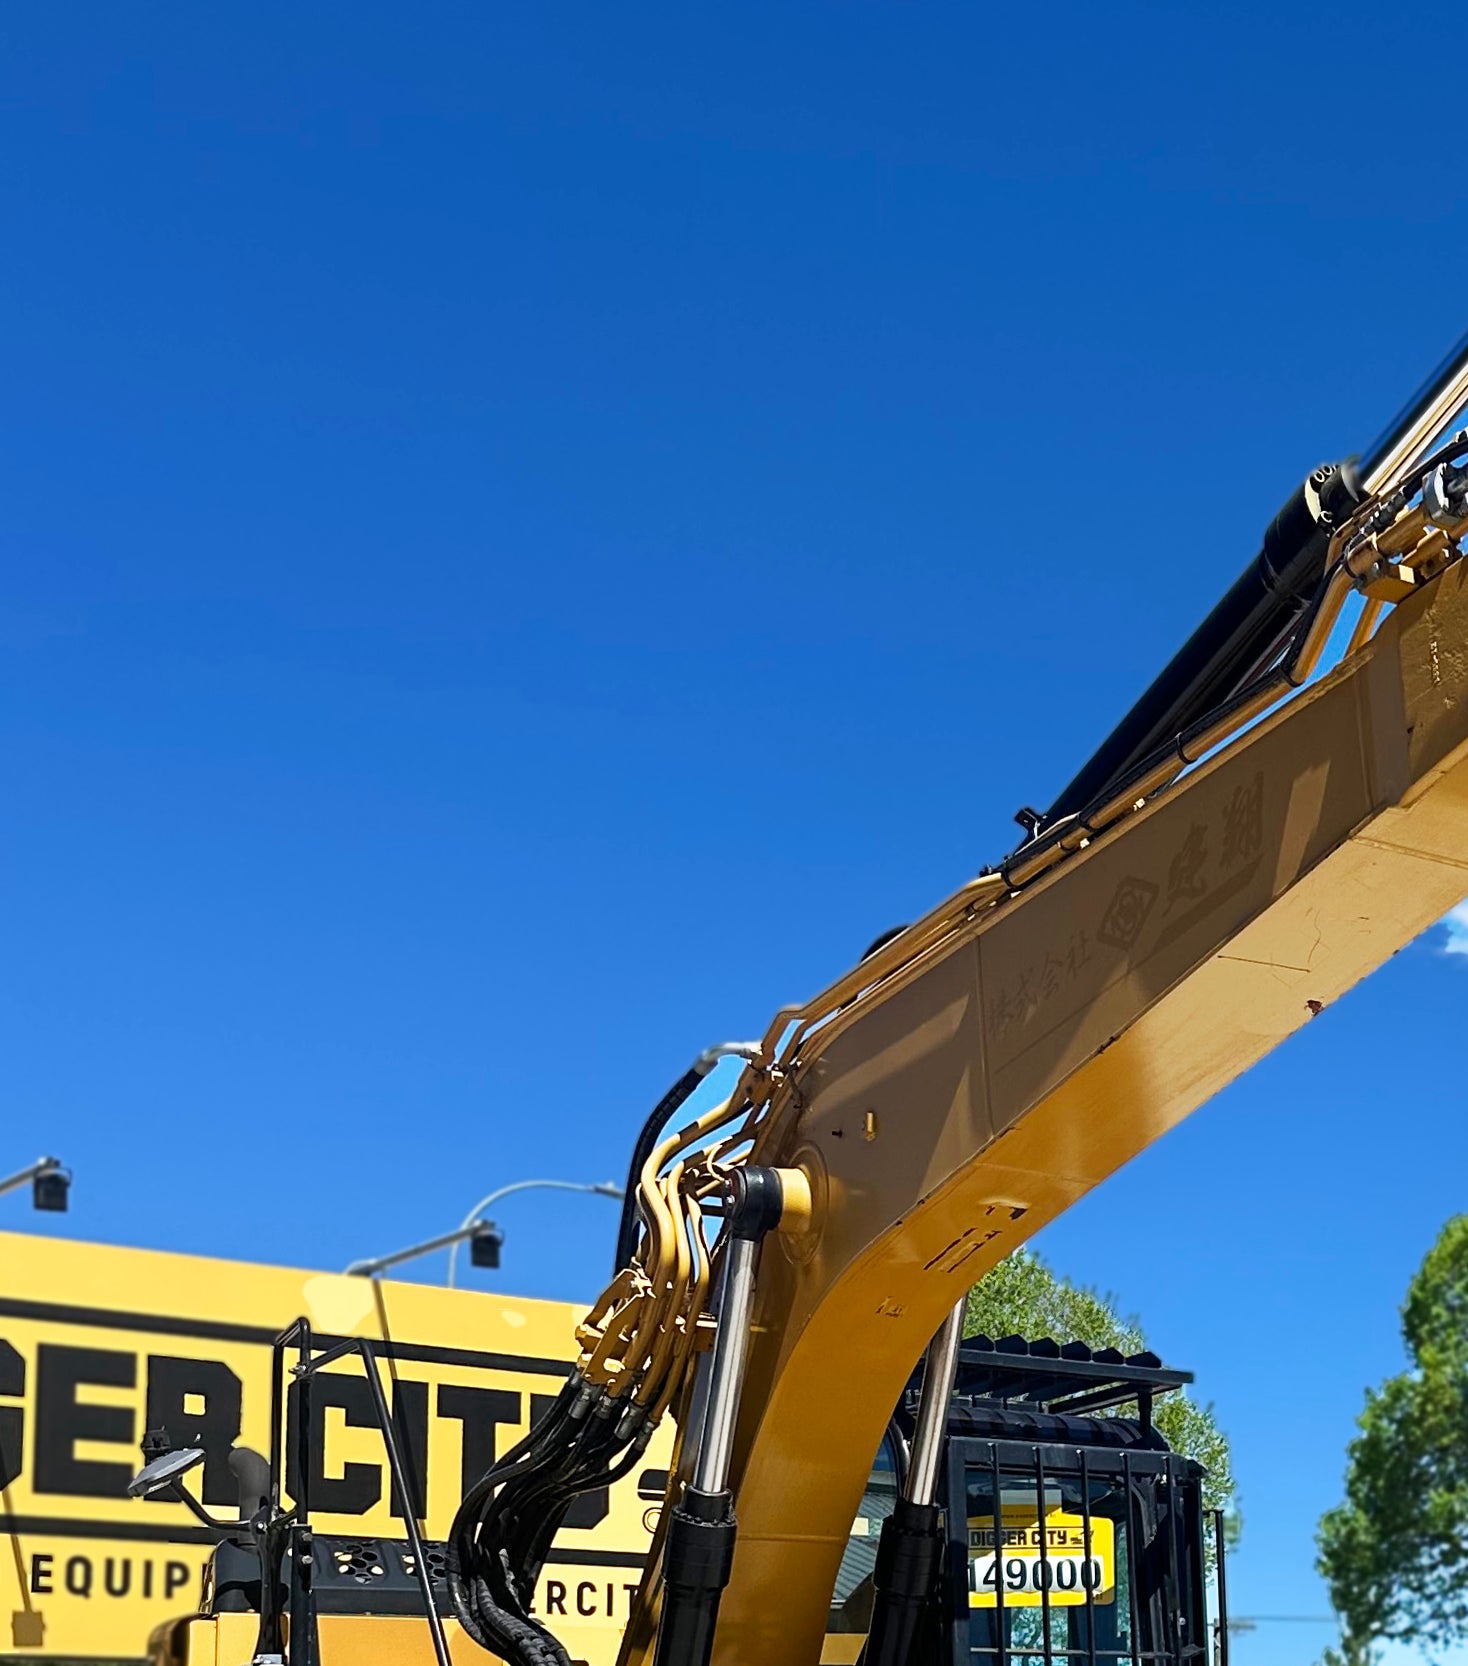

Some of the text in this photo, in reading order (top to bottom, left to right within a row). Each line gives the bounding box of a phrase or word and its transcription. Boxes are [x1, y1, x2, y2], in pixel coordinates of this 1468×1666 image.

[0, 1338, 243, 1508] ER
[1031, 1530, 1067, 1545] CTY
[31, 1554, 208, 1600] EQUIP
